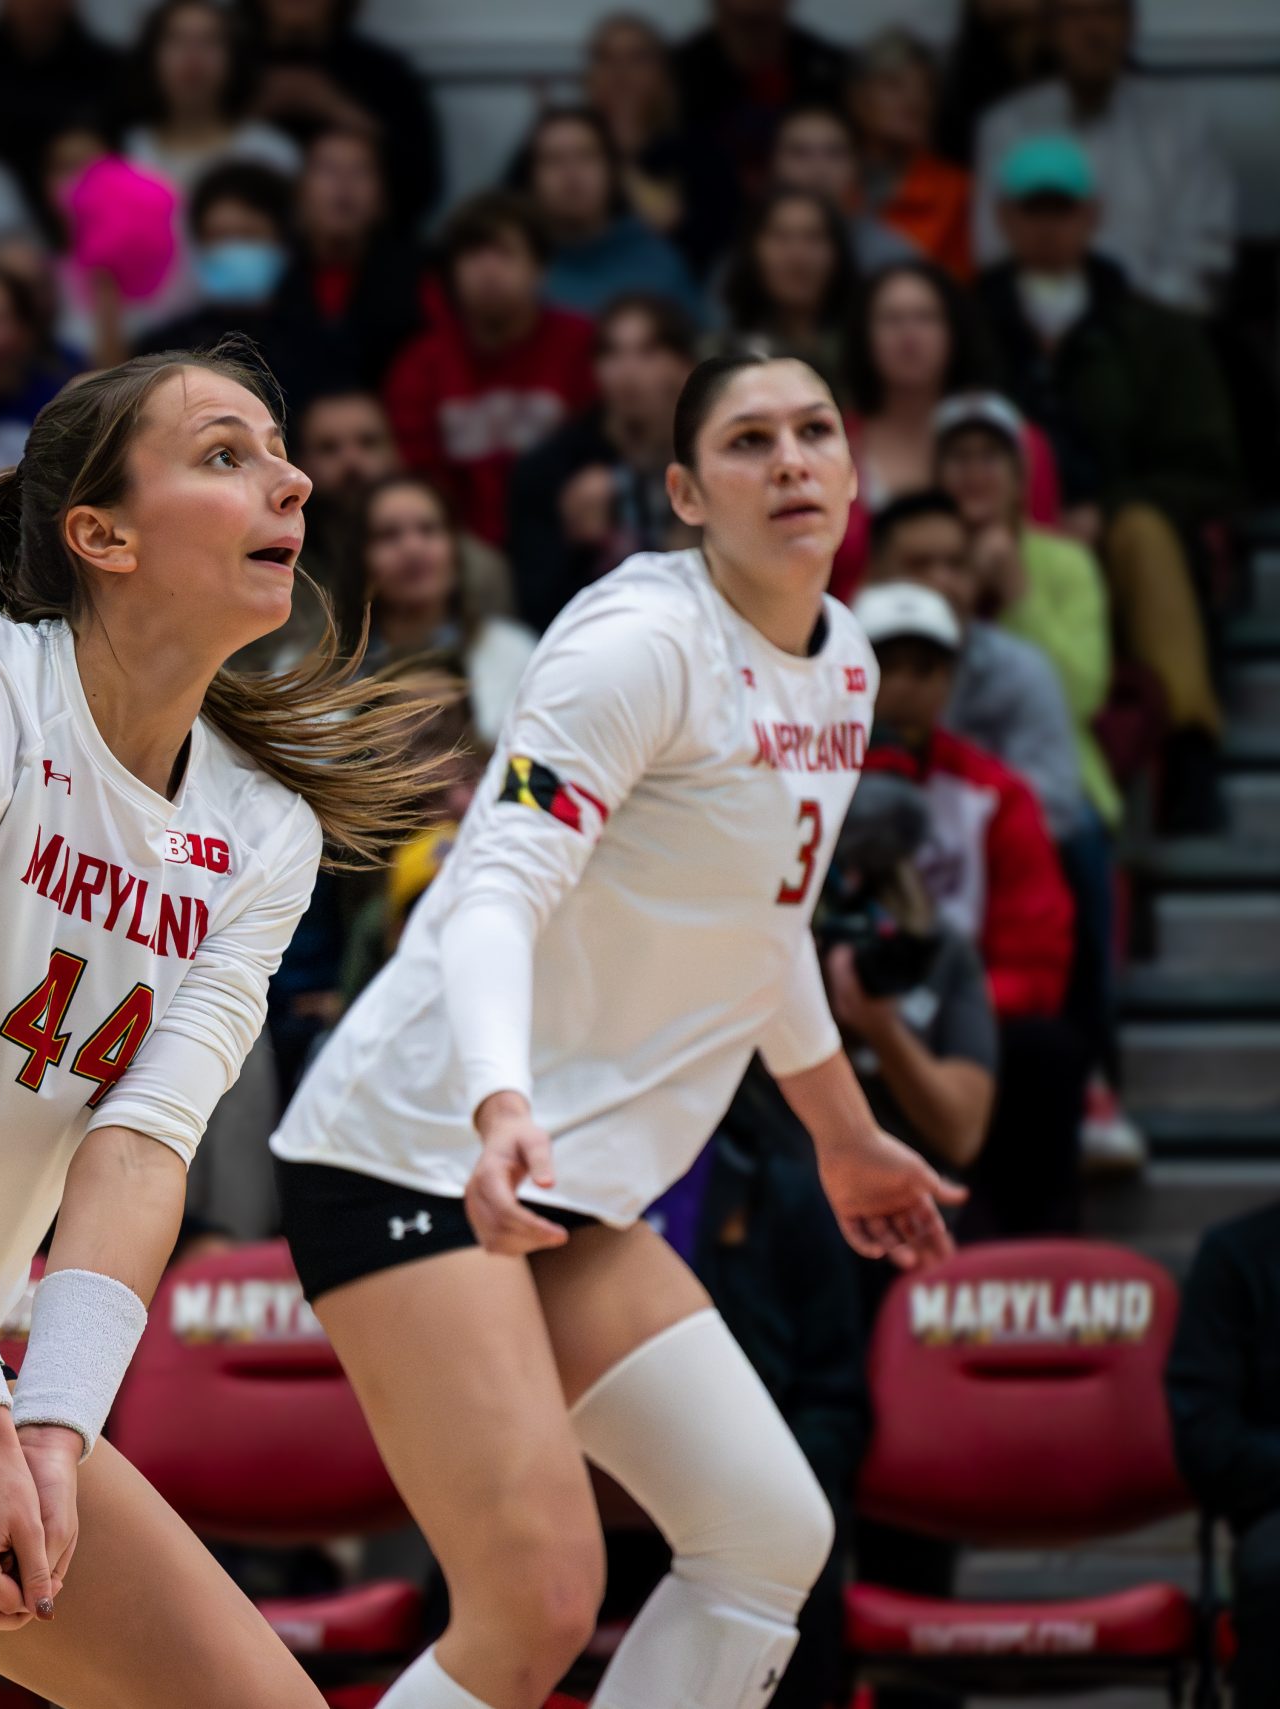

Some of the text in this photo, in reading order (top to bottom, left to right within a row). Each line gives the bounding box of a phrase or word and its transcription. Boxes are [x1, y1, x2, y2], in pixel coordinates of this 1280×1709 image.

[21, 823, 209, 961] MARYLND
[775, 799, 823, 905] 3
[910, 1279, 1154, 1335] MARYLAND
